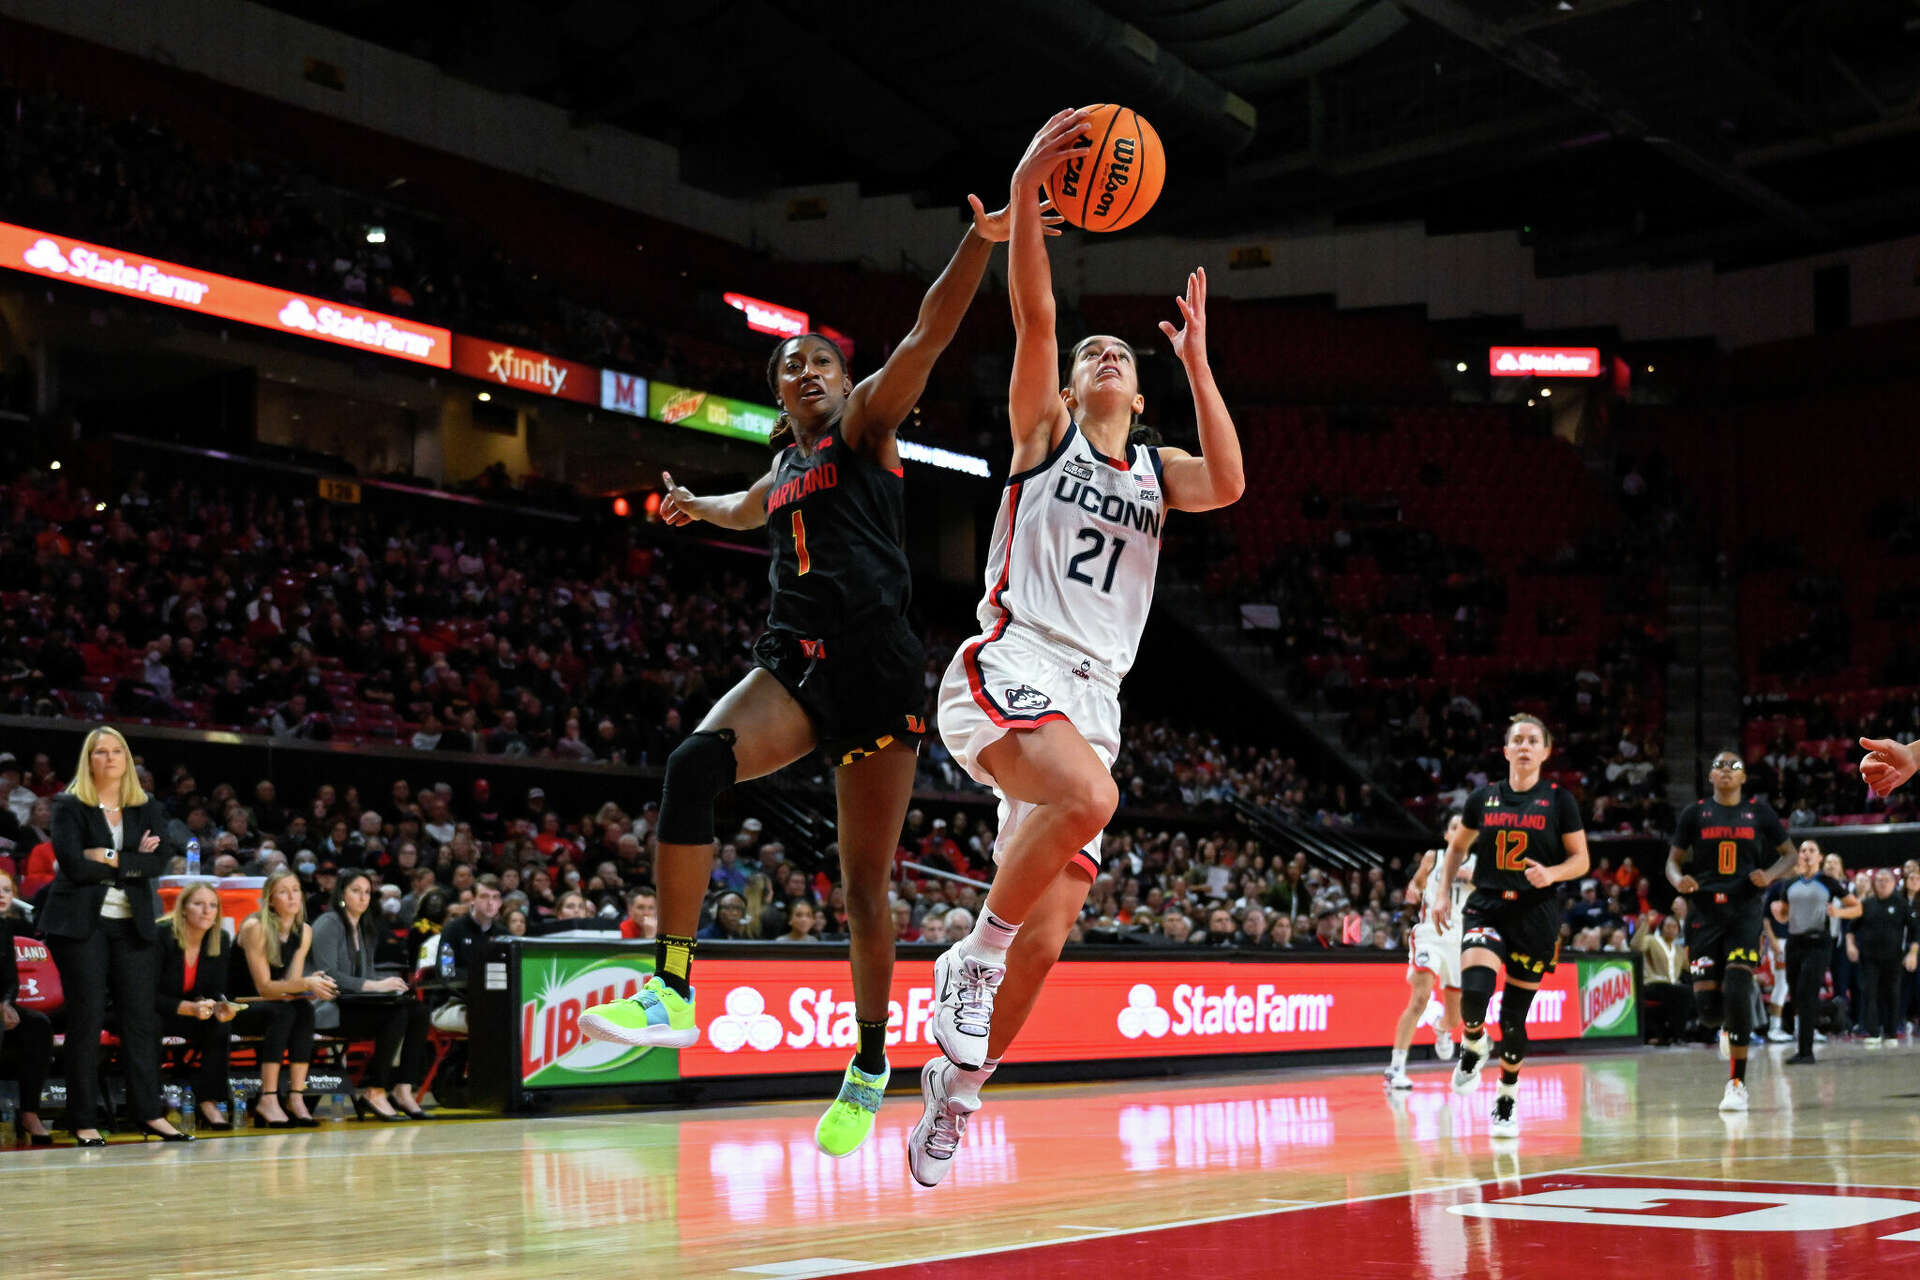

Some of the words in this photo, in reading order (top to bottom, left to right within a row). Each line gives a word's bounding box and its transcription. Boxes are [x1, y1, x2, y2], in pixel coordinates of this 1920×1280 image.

[1093, 138, 1136, 217] Wilson
[488, 347, 568, 395] xfinity
[1054, 475, 1160, 539] UCONN
[791, 508, 810, 577] 1
[1067, 527, 1126, 594] 21
[1483, 812, 1547, 831] MARYLAND
[1701, 826, 1755, 840] MARYLAND
[1495, 829, 1528, 871] 12
[1718, 841, 1736, 875] 0
[1172, 984, 1334, 1036] StateFarm
[1582, 972, 1632, 1027] LIBMAN
